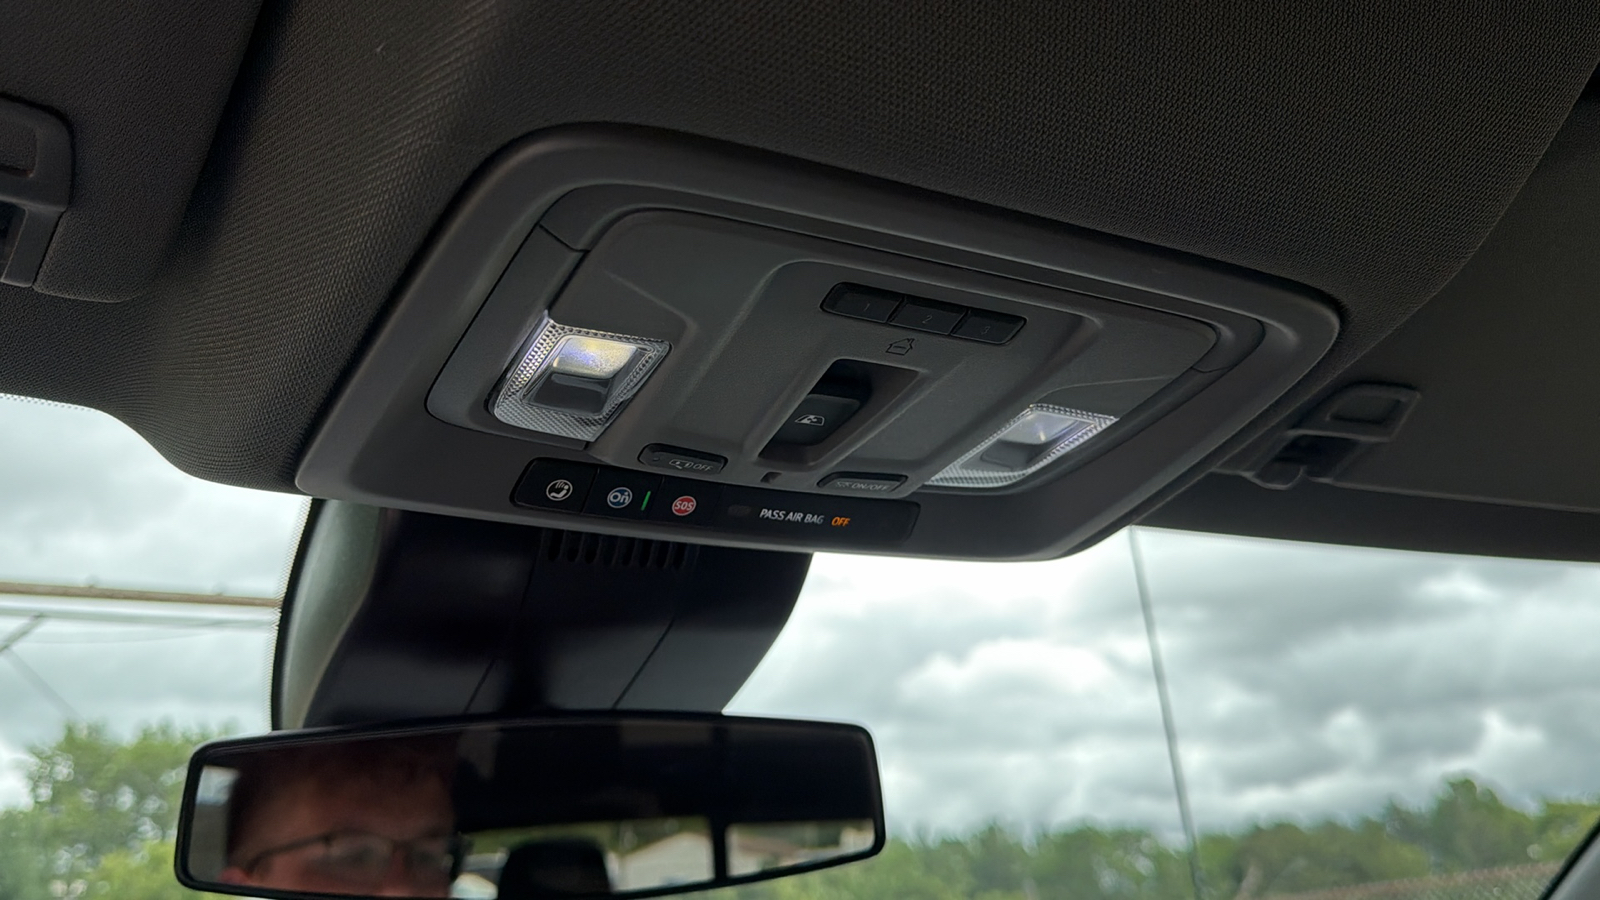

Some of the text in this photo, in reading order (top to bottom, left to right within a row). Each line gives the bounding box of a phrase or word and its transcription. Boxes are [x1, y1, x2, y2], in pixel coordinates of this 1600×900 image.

[922, 314, 933, 325] 2
[980, 325, 991, 335] 3
[693, 463, 714, 472] OFF
[851, 482, 892, 491] ON/OFF
[674, 500, 695, 512] SOS
[759, 508, 850, 527] PASS AIR BAG OFF
